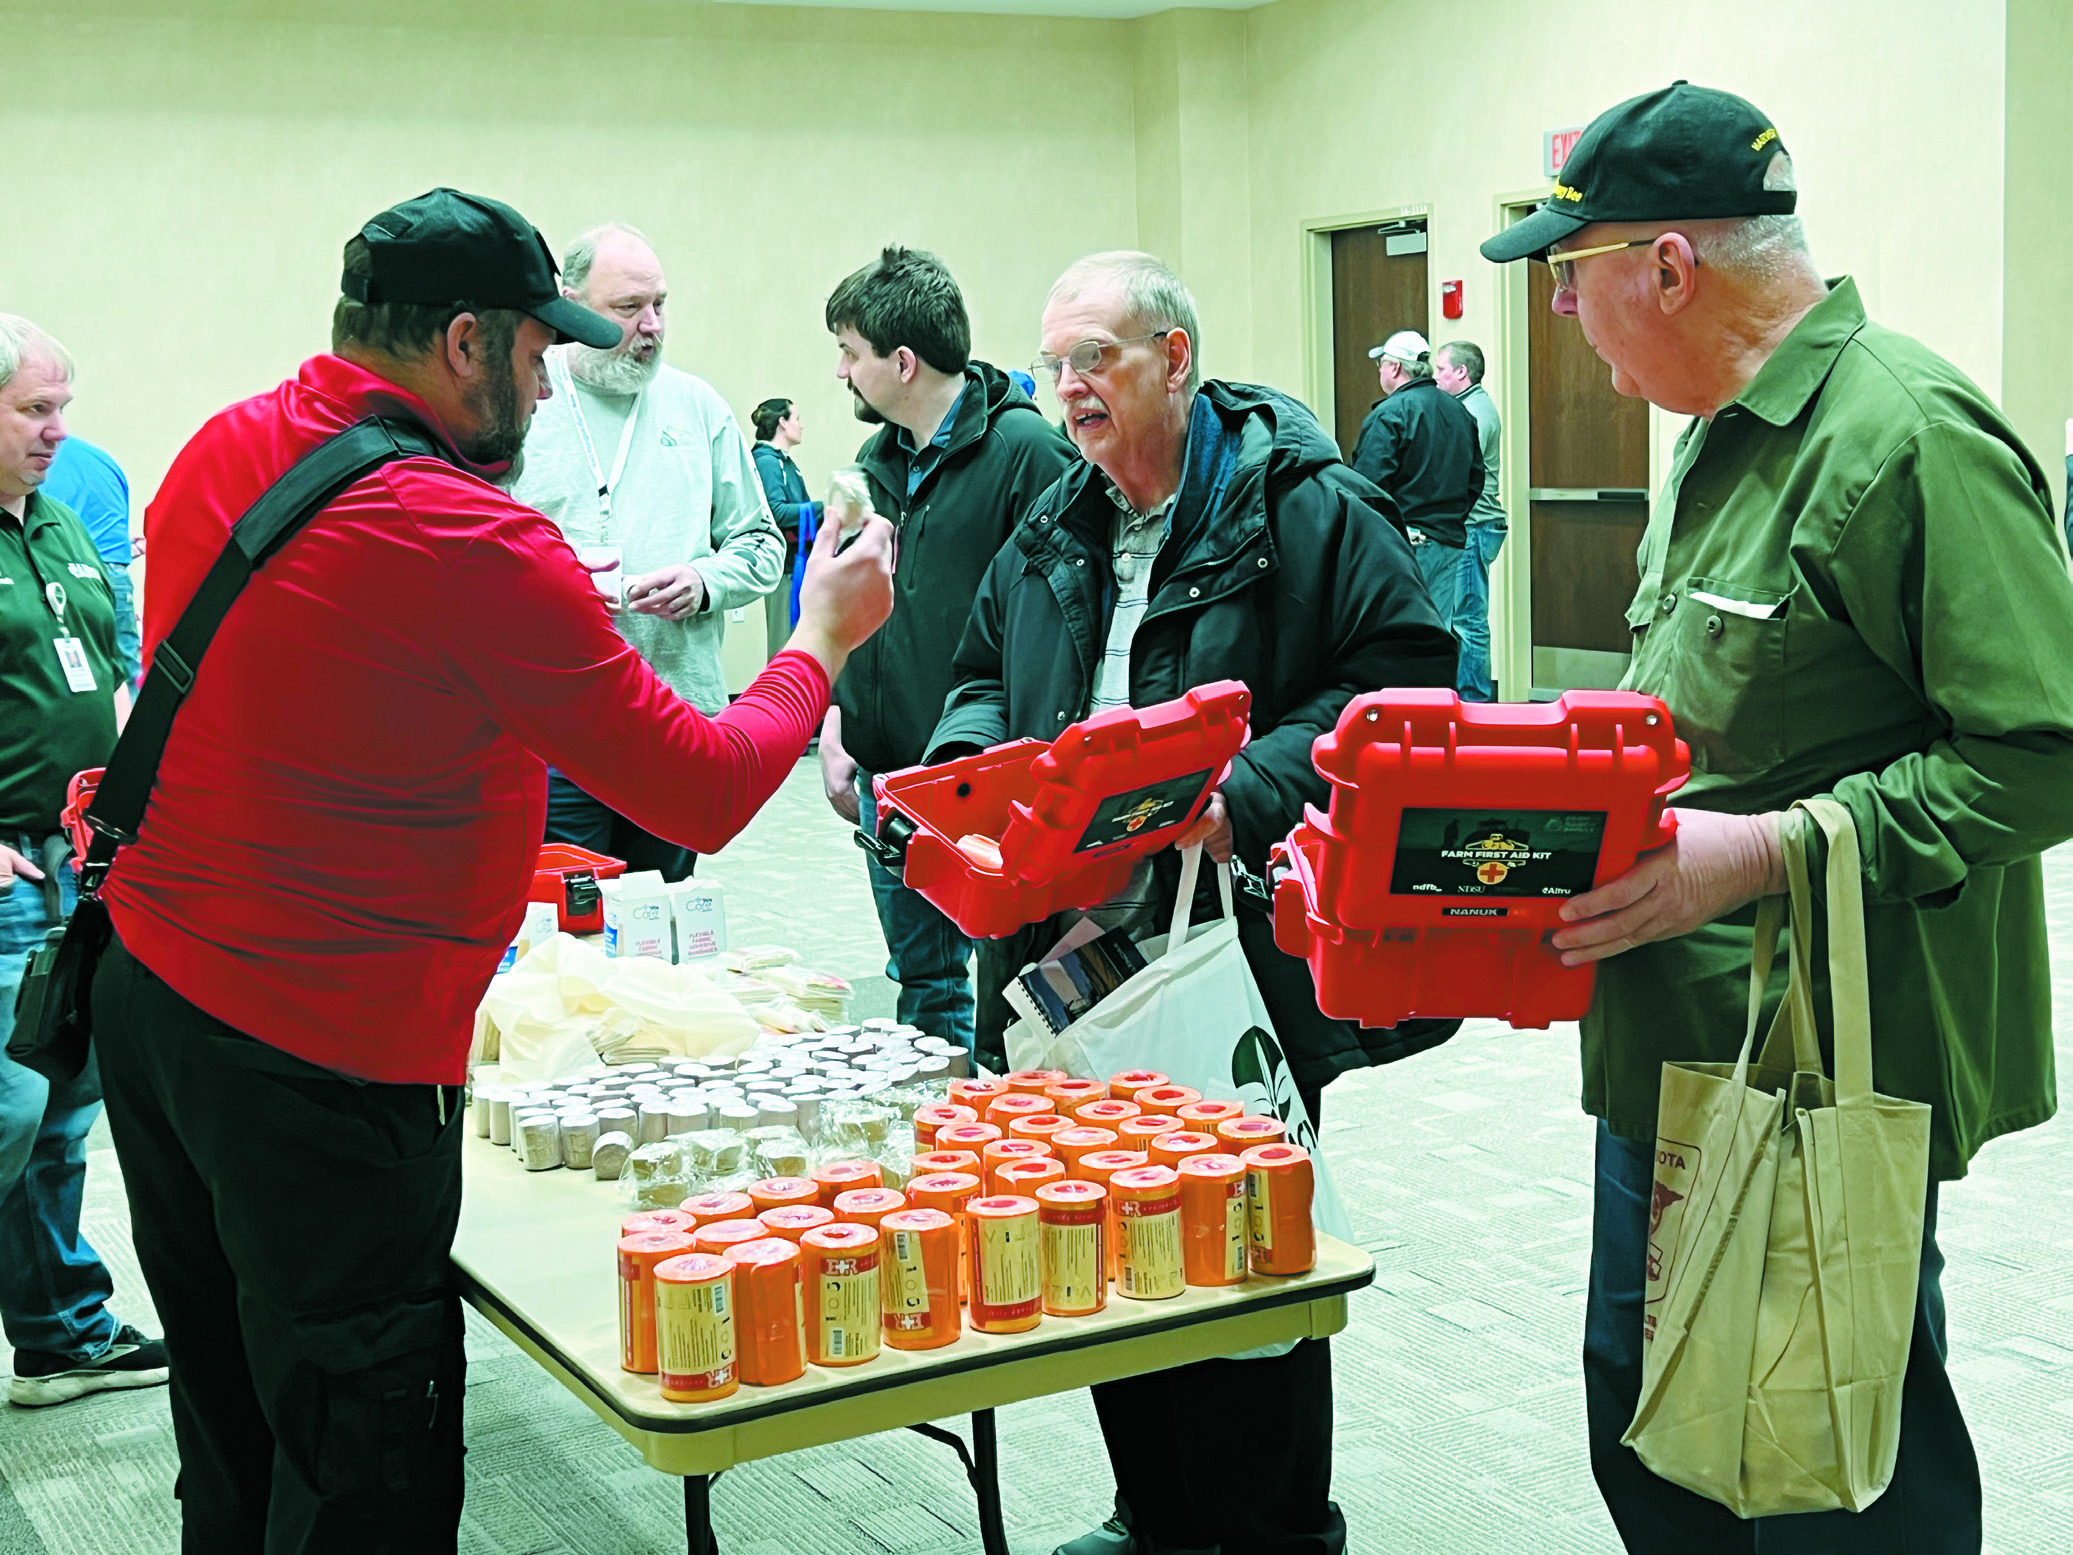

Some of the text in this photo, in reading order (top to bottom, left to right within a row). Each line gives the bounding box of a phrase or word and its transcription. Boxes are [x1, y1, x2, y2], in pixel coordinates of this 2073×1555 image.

[1441, 850, 1474, 858] FARM
[1475, 851, 1508, 859] FIRST
[1510, 851, 1530, 859] AID
[1450, 908, 1498, 916] NANUK
[1657, 1151, 1686, 1170] OTA
